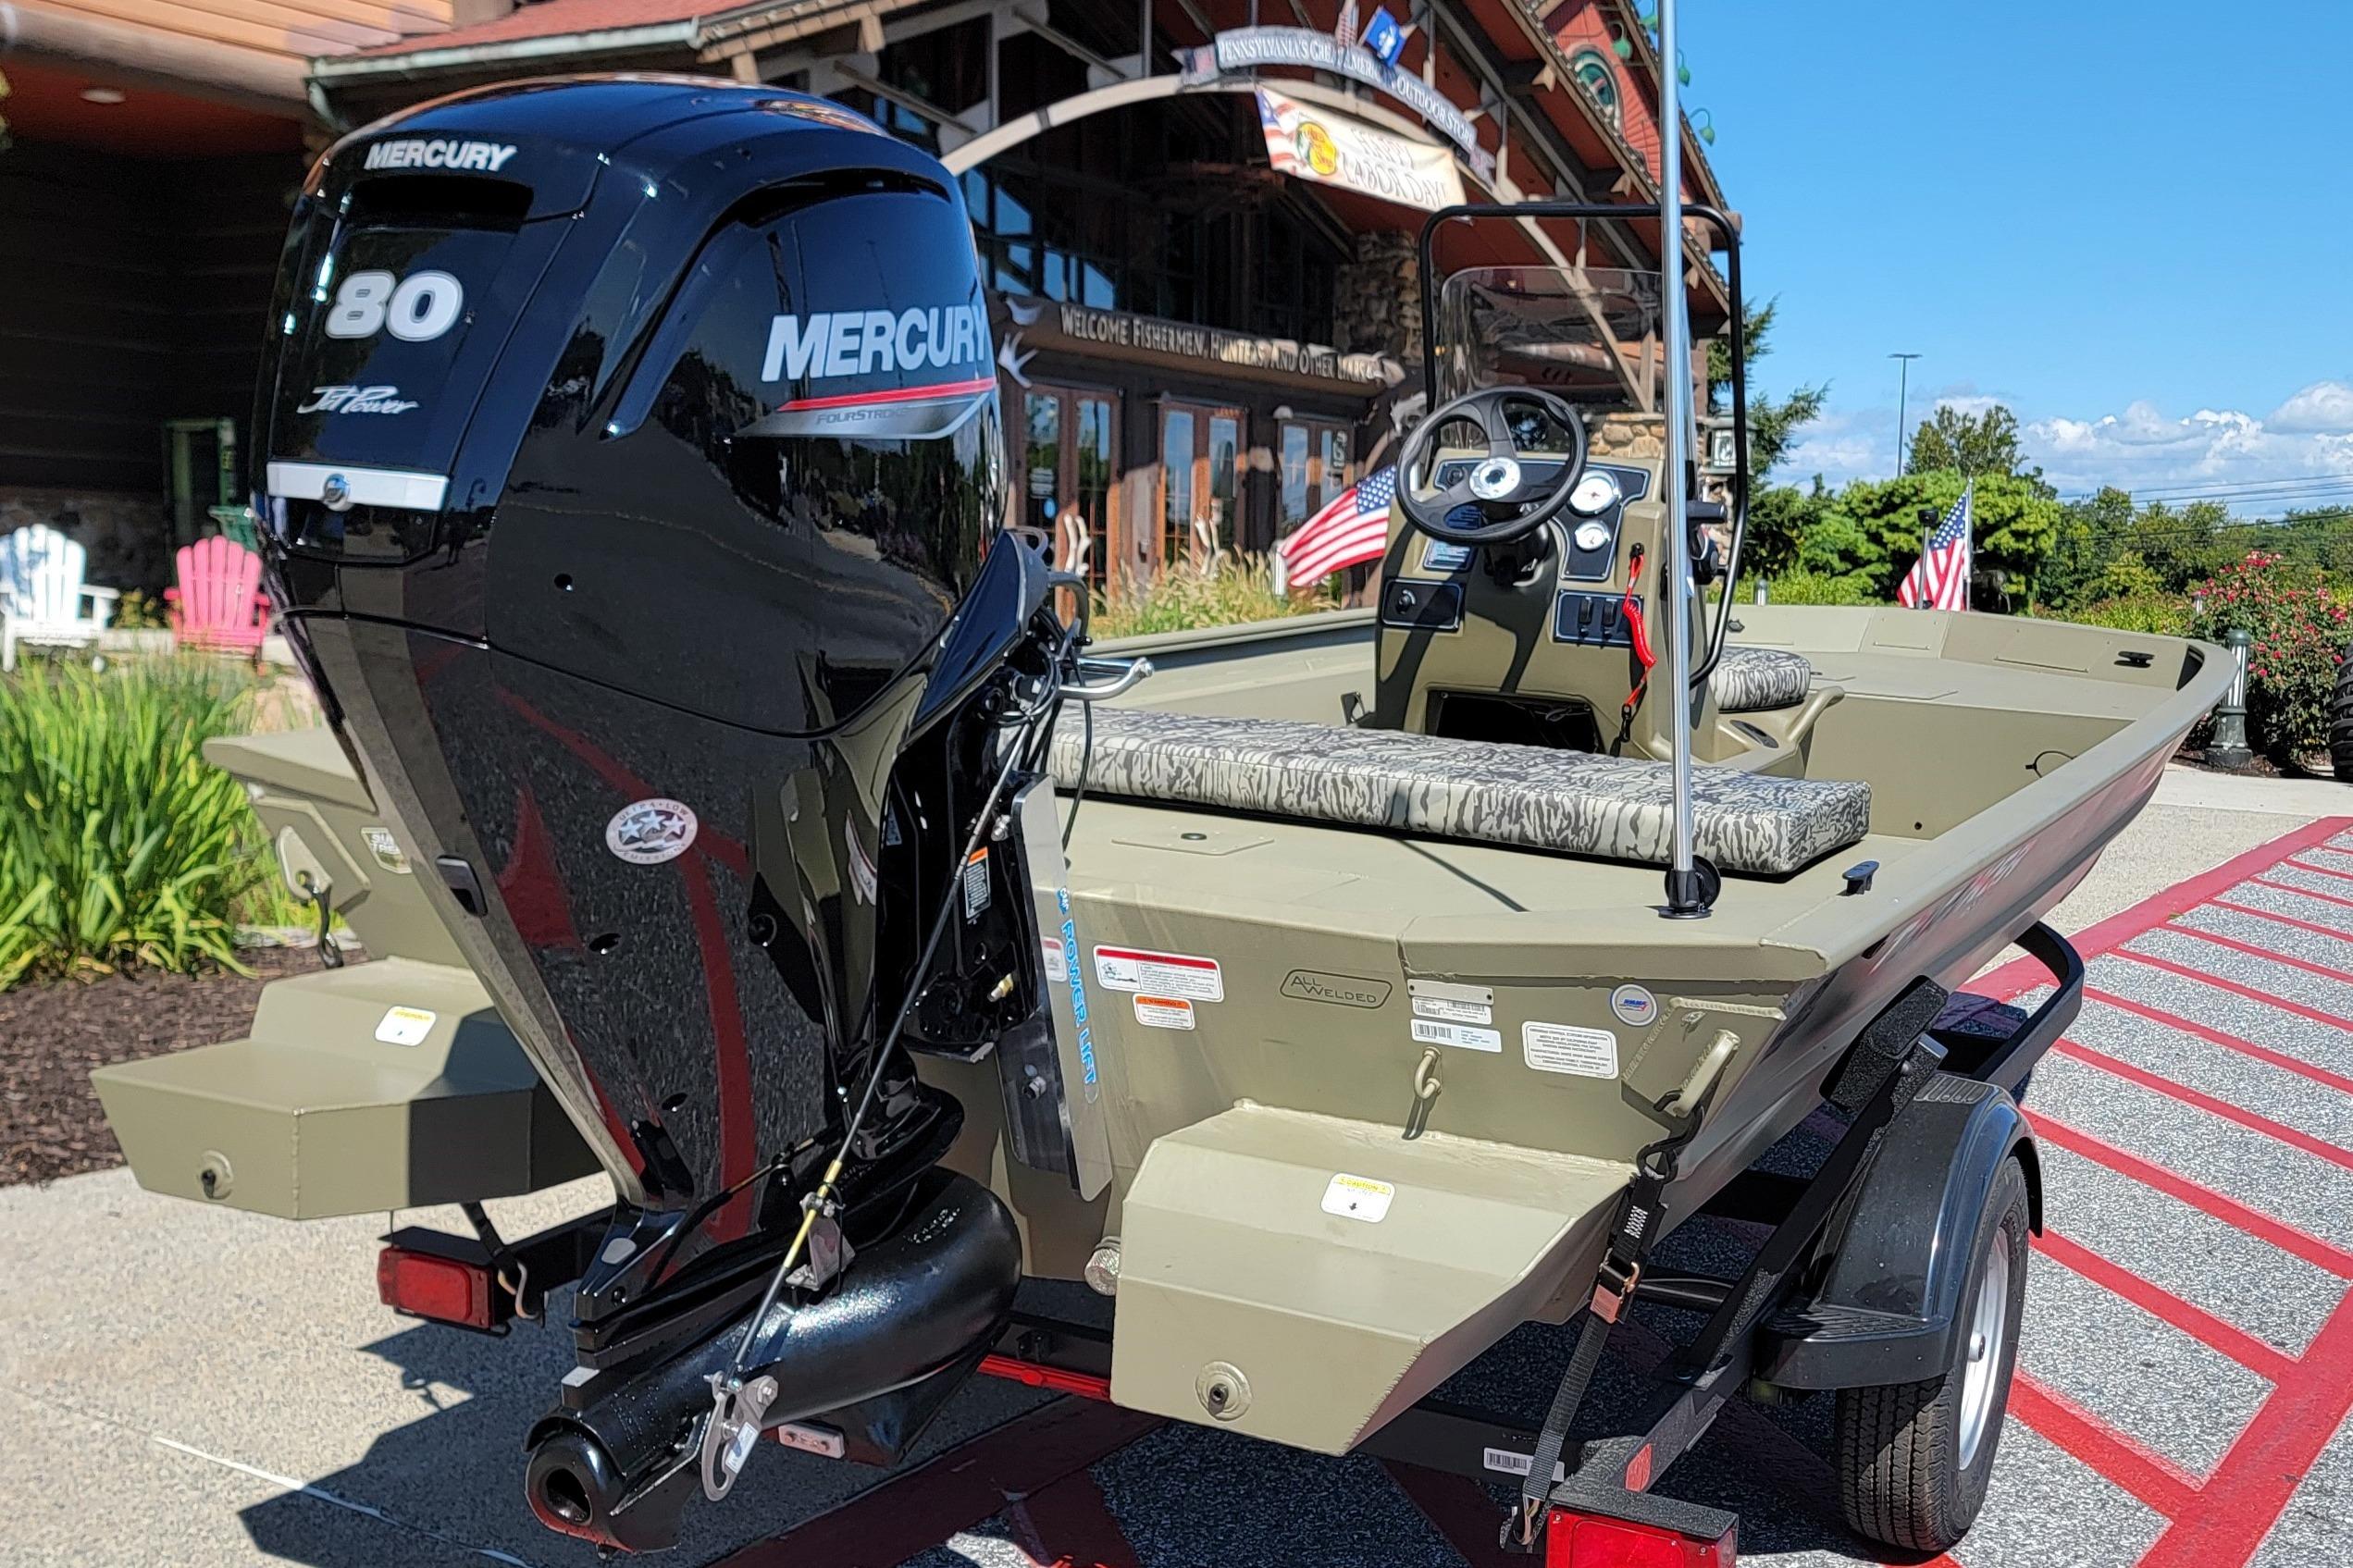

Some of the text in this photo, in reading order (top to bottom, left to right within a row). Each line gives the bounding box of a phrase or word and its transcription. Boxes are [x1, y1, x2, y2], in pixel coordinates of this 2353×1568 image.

[1396, 74, 1445, 124] OUTDOOR
[364, 140, 518, 172] MERCURY
[1342, 152, 1407, 199] LABOR
[324, 268, 464, 342] 80
[1059, 304, 1128, 346] WELCOME
[761, 304, 987, 382] MERCURY
[665, 802, 689, 816] LOW
[1061, 918, 1096, 1084] POWER LIFT
[1290, 975, 1322, 988] ALL
[1301, 984, 1377, 1004] WELDED
